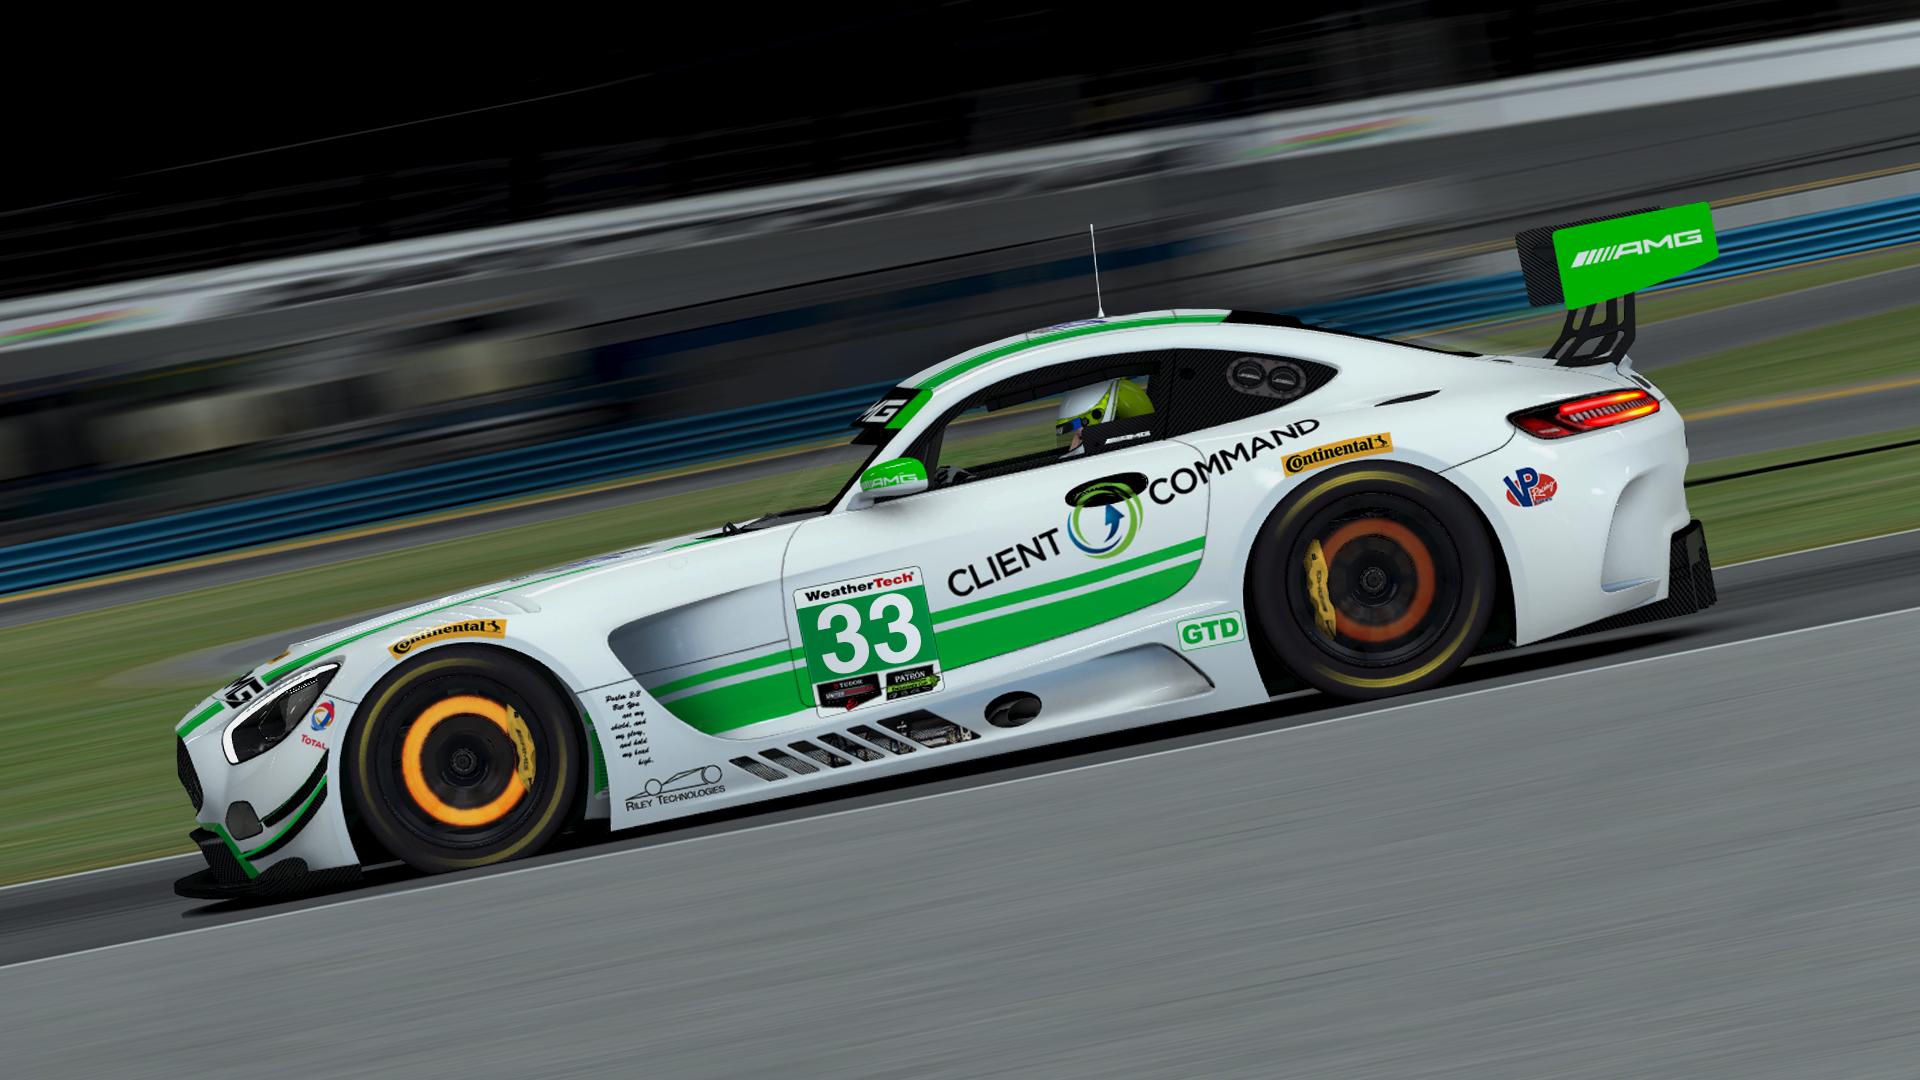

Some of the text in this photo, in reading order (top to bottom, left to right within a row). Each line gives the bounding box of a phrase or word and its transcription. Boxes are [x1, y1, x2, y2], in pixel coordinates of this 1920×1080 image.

[1285, 437, 1375, 473] Continental
[1503, 467, 1539, 507] VP
[948, 418, 1321, 598] CLIENT COMMAND
[393, 619, 485, 655] Continental
[816, 593, 922, 675] 33
[1182, 617, 1239, 645] GTD
[301, 734, 328, 750] TOTAL
[625, 784, 726, 812] RILEY TECHNOLOGIES
